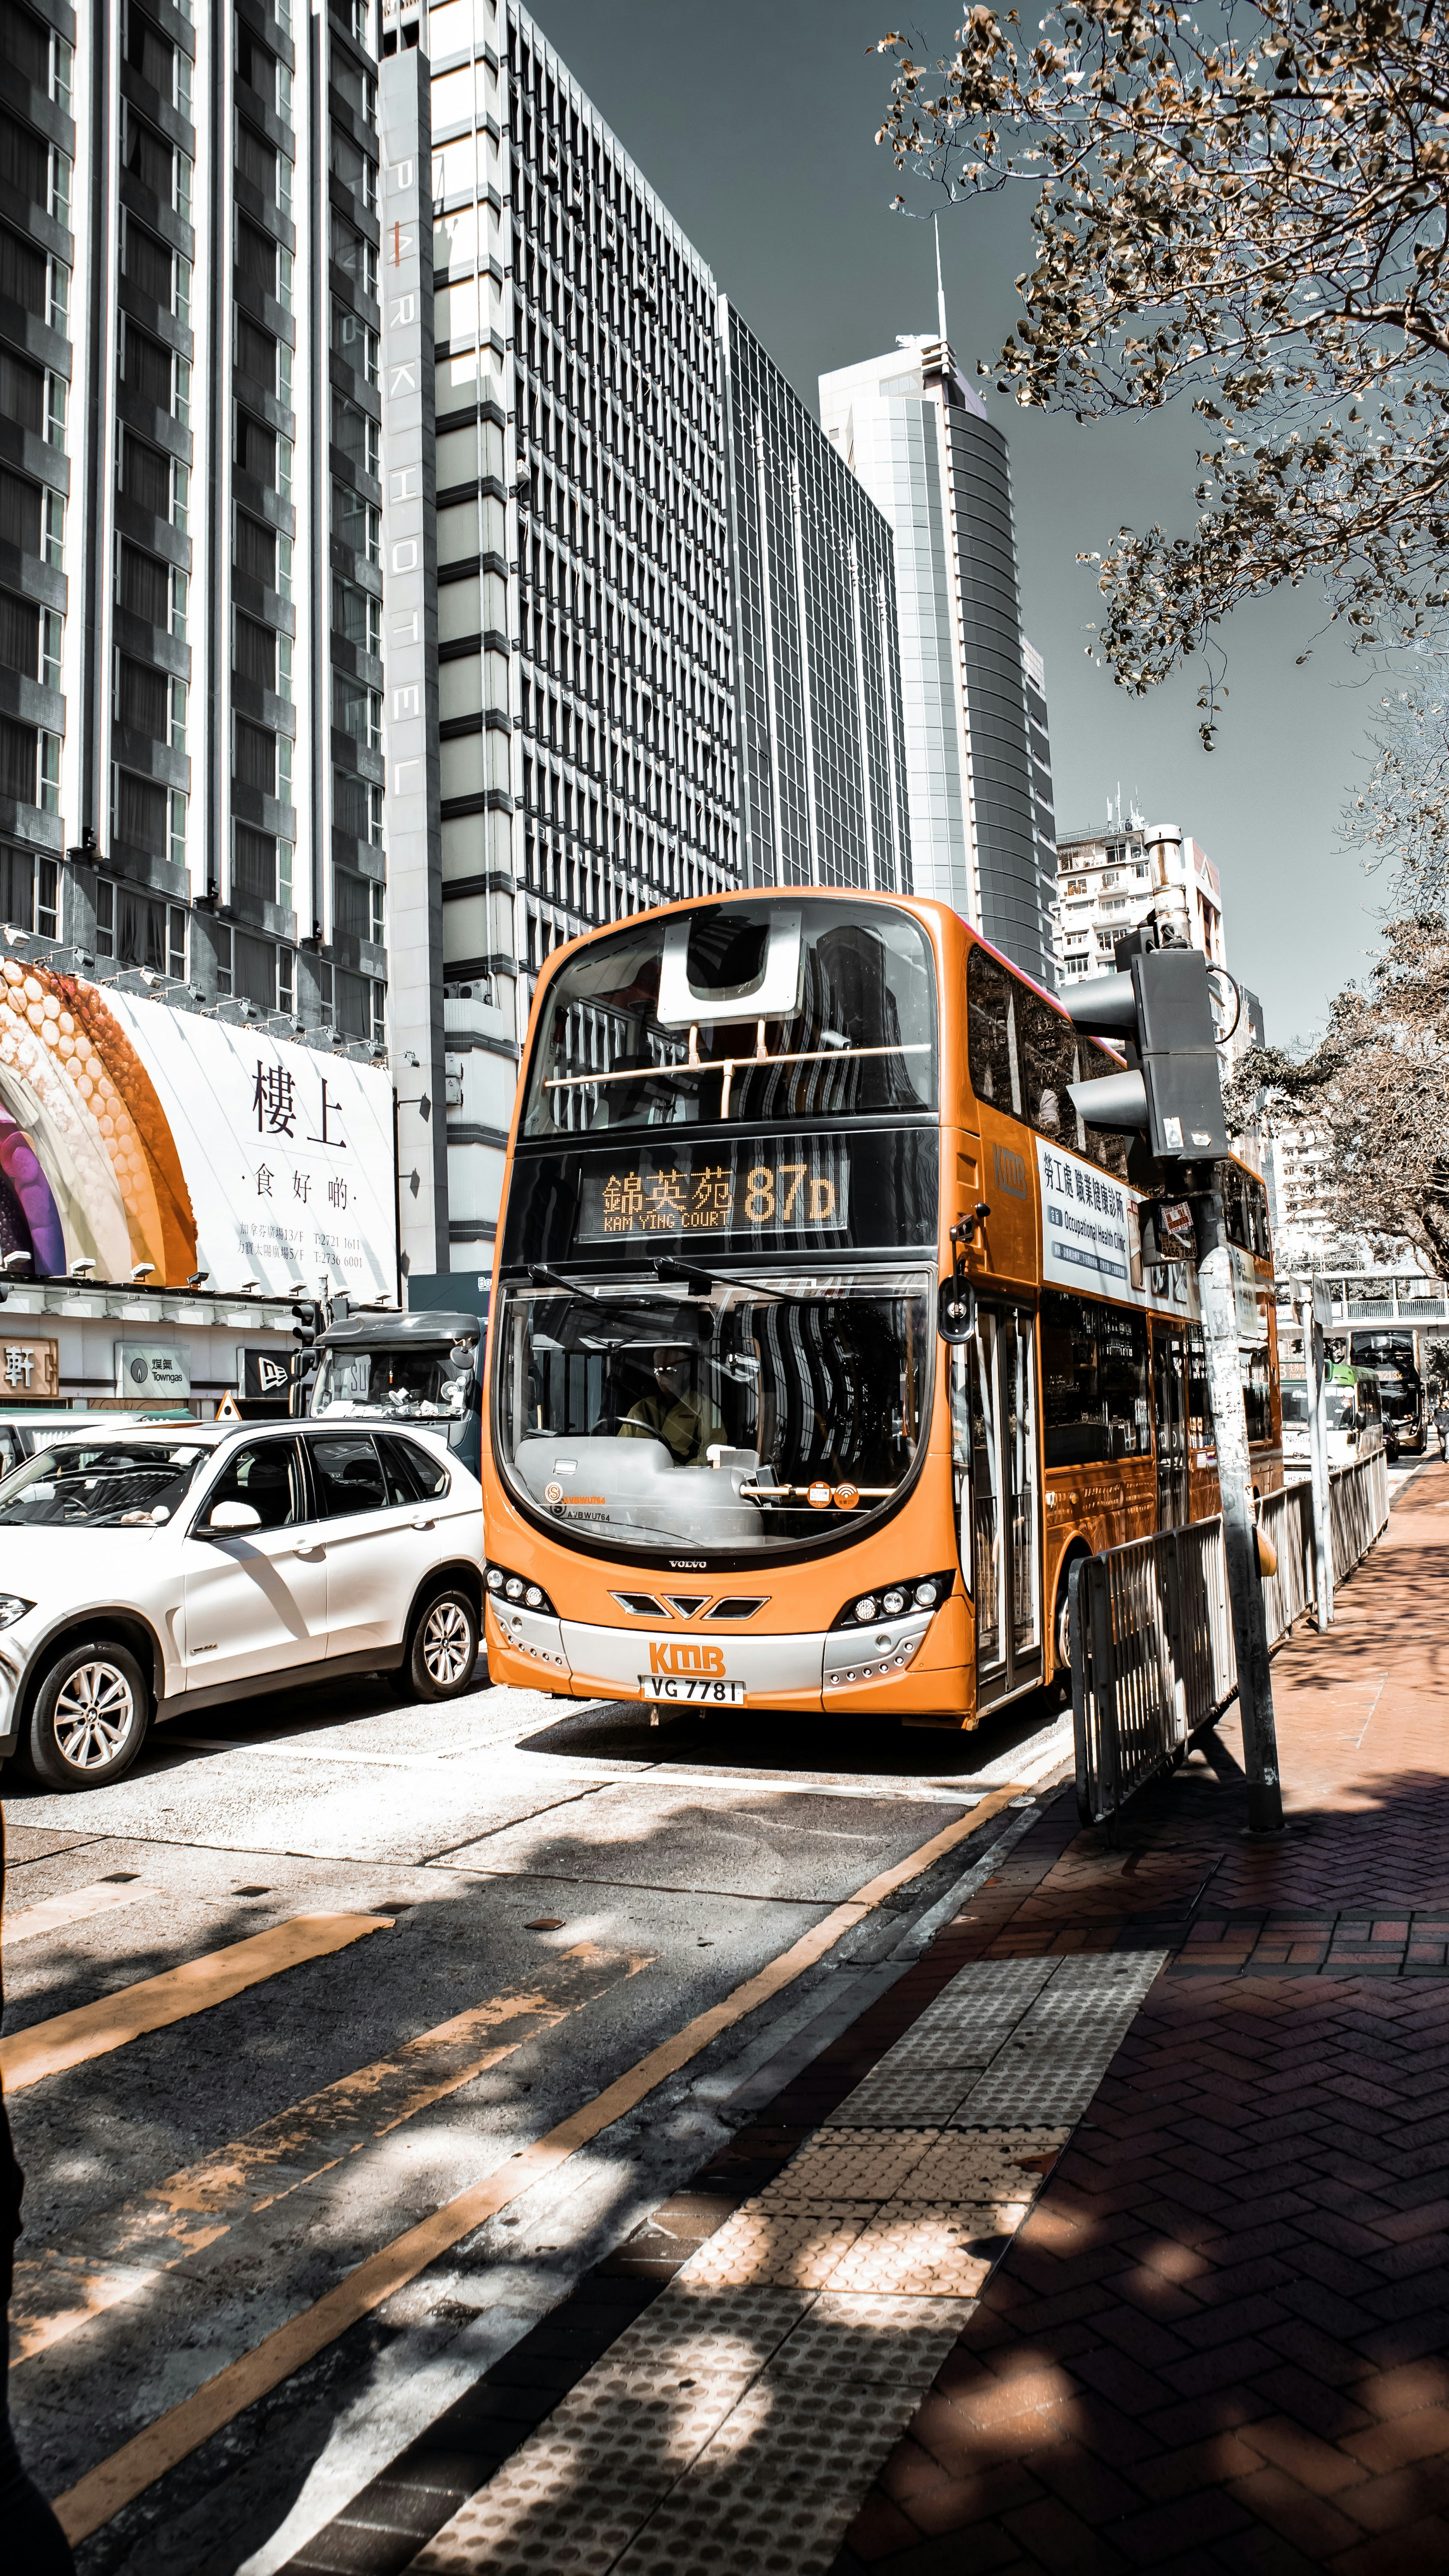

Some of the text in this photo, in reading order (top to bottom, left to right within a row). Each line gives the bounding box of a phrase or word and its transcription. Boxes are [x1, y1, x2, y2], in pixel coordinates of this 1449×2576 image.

[389, 161, 420, 795] PARK HOTEL
[252, 1060, 346, 1148] 樓上
[253, 1163, 347, 1210] 食好啲
[992, 1142, 1027, 1200] KMB
[603, 1166, 733, 1215] 錦英苑
[745, 1164, 835, 1222] 87D
[603, 1210, 729, 1232] KAM YING COURT
[1064, 1210, 1126, 1253] Occupational Health Clinic
[313, 1233, 339, 1247] T:2721
[344, 1237, 360, 1250] 1611
[314, 1251, 340, 1265] T:2736
[344, 1256, 362, 1268] 6001
[4, 1346, 34, 1387] 軒
[152, 1358, 173, 1370] 煤氣
[152, 1372, 183, 1383] Towngas
[563, 1496, 606, 1504] AVBWU764
[669, 1560, 707, 1568] VOLVO
[649, 1642, 726, 1678] KMB
[651, 1677, 736, 1702] VG 7781
